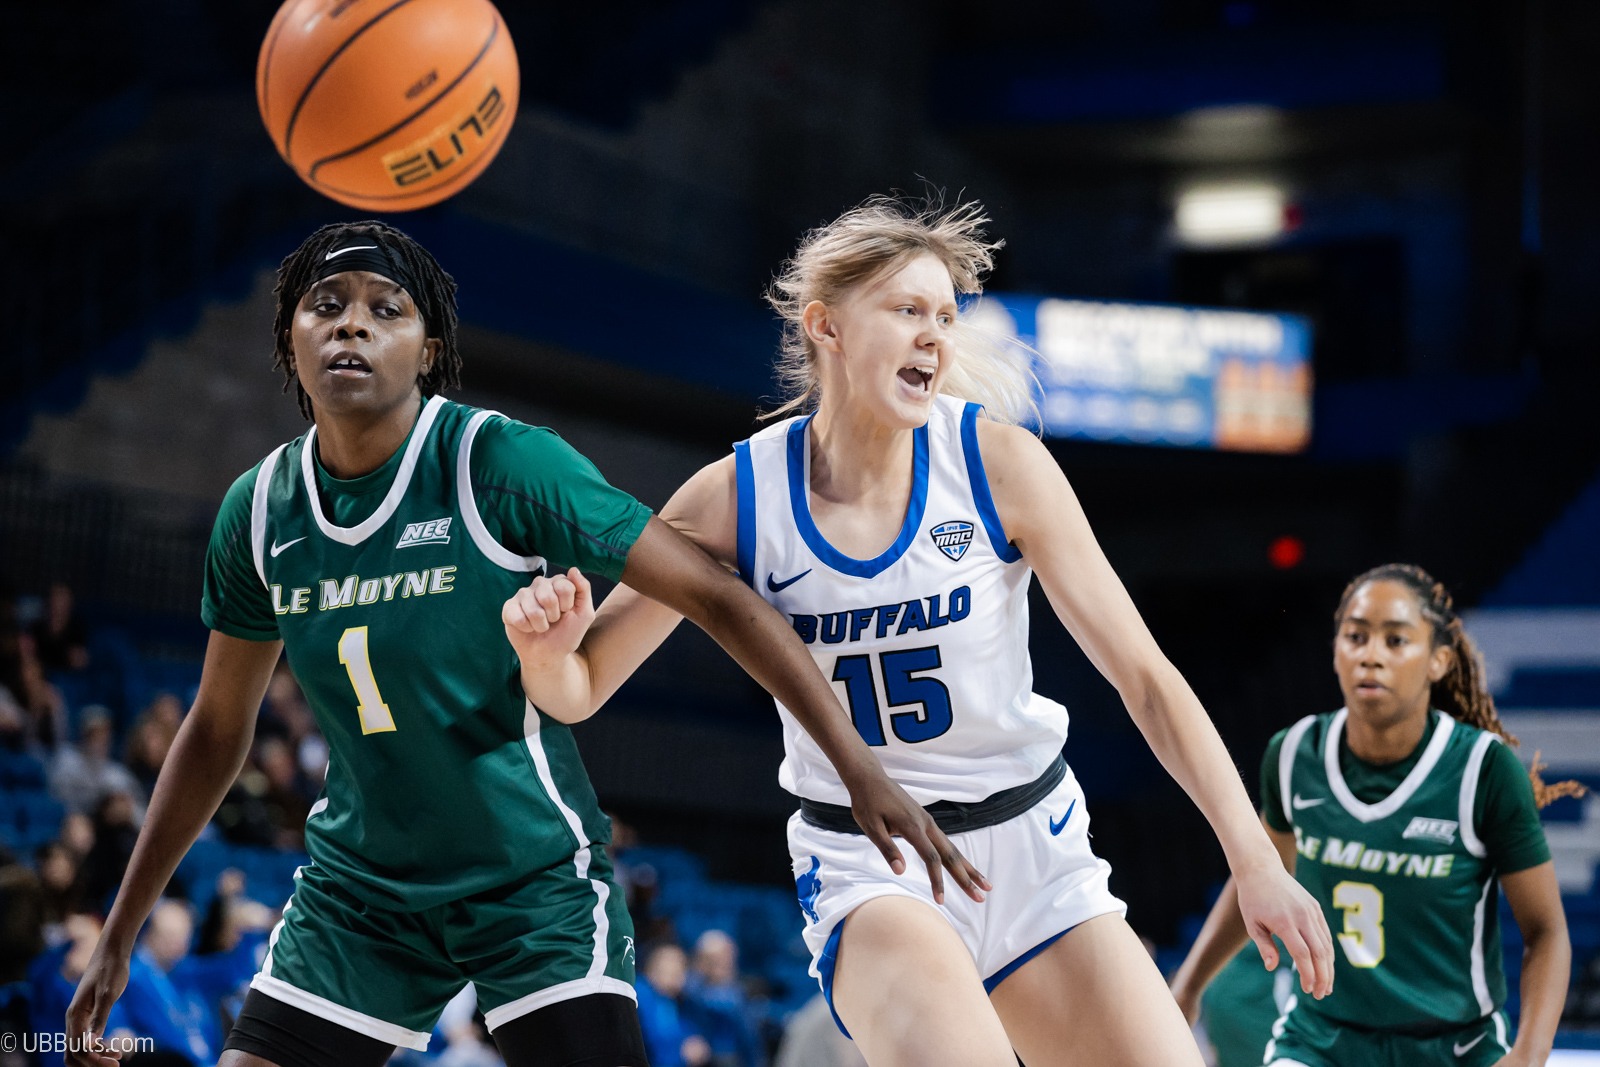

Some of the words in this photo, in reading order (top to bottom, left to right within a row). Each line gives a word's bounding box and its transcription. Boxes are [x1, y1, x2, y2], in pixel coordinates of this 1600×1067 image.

[390, 86, 504, 187] ELITE
[402, 518, 448, 542] NEC
[935, 531, 972, 547] MAC
[270, 584, 310, 614] LE
[319, 565, 457, 611] MOYNE
[789, 585, 971, 645] BUFFALO
[338, 626, 397, 736] 1
[831, 645, 954, 747] 15
[1321, 837, 1455, 878] MOYNE
[1333, 880, 1385, 968] 3
